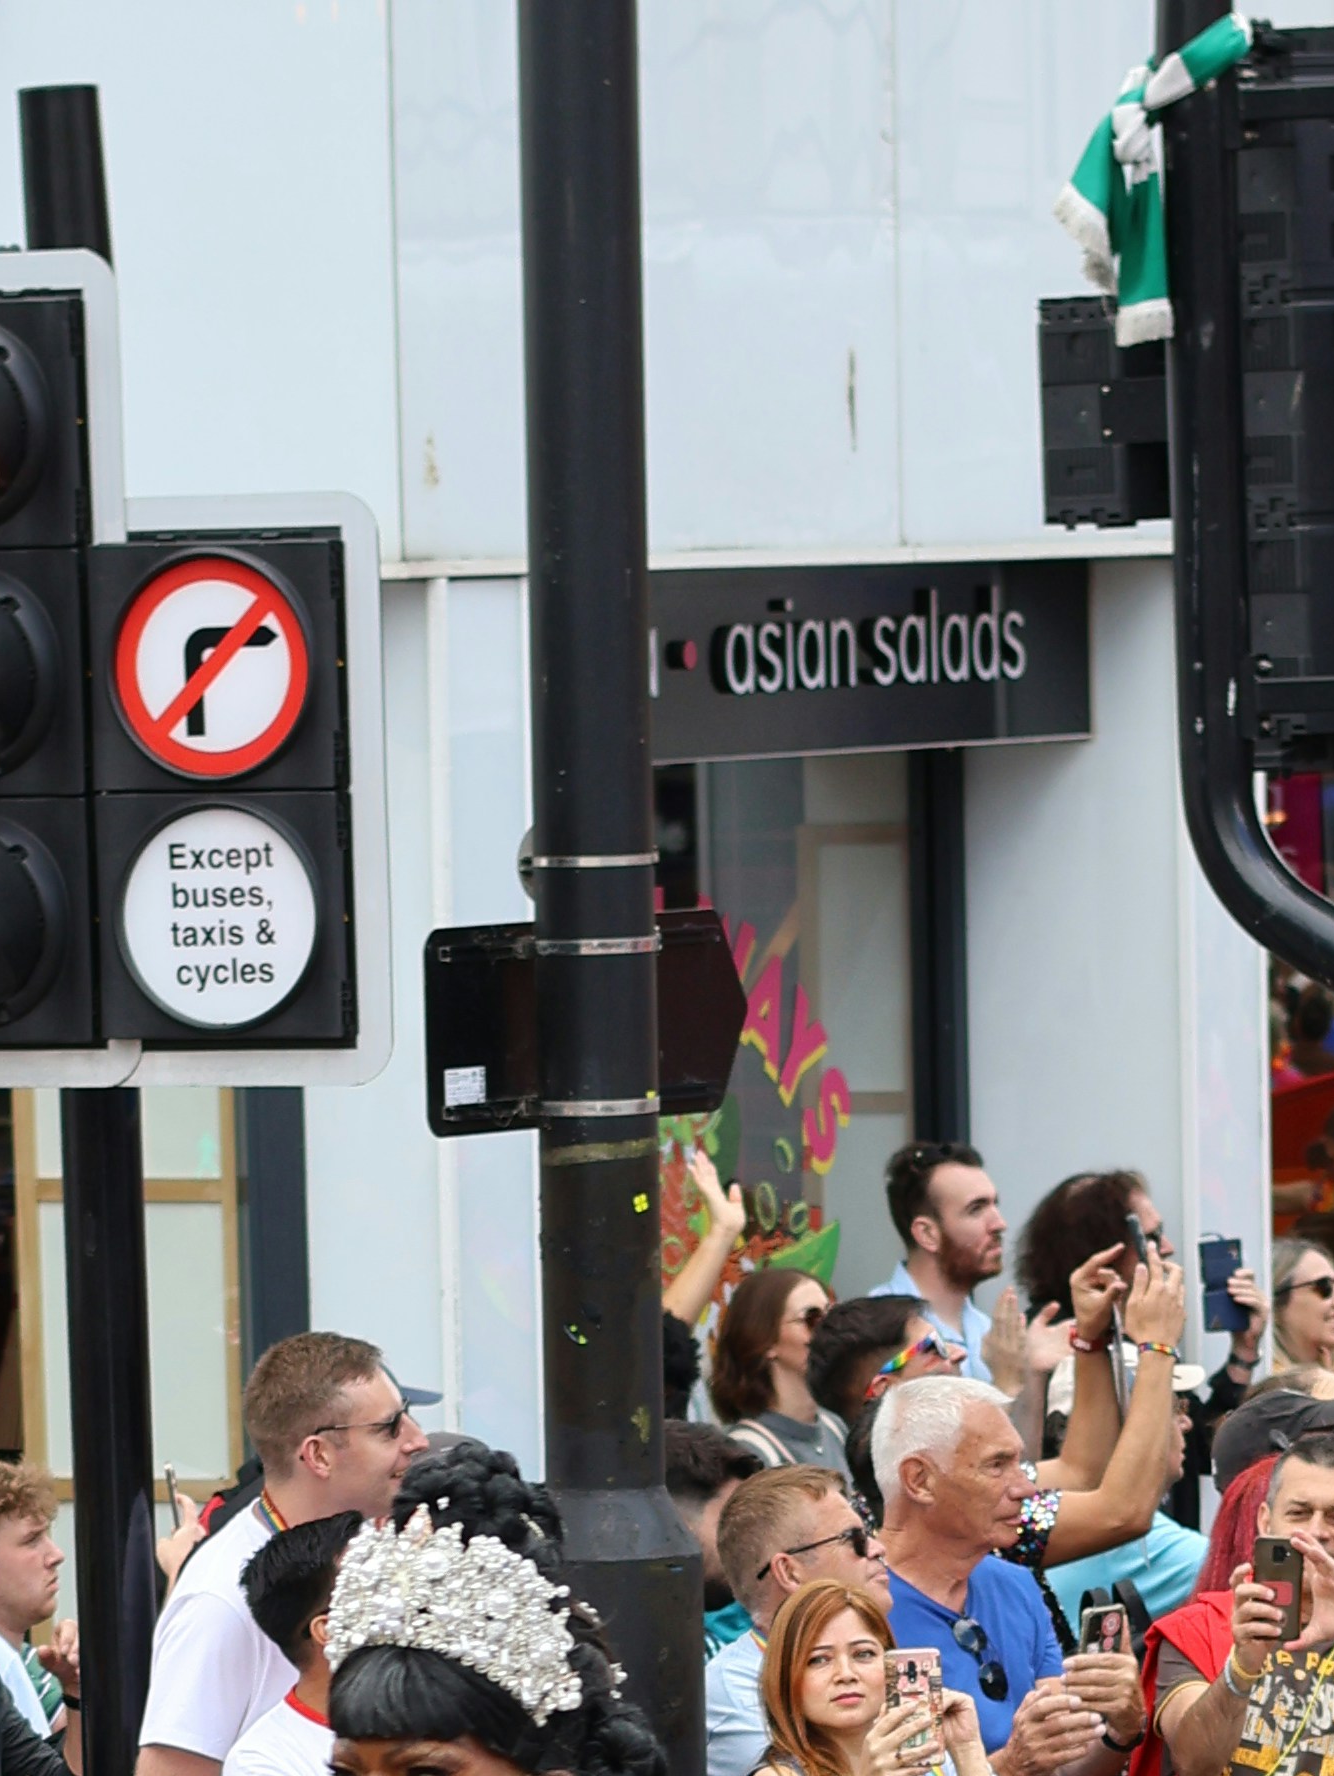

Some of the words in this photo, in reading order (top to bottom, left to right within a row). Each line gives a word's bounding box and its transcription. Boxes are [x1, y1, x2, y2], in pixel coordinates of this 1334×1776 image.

[724, 597, 859, 696] asian
[872, 585, 1028, 688] salads
[167, 841, 275, 876] Except
[171, 881, 274, 912] buses,
[170, 918, 245, 948] taxis
[255, 917, 277, 946] &
[175, 957, 275, 993] cycles
